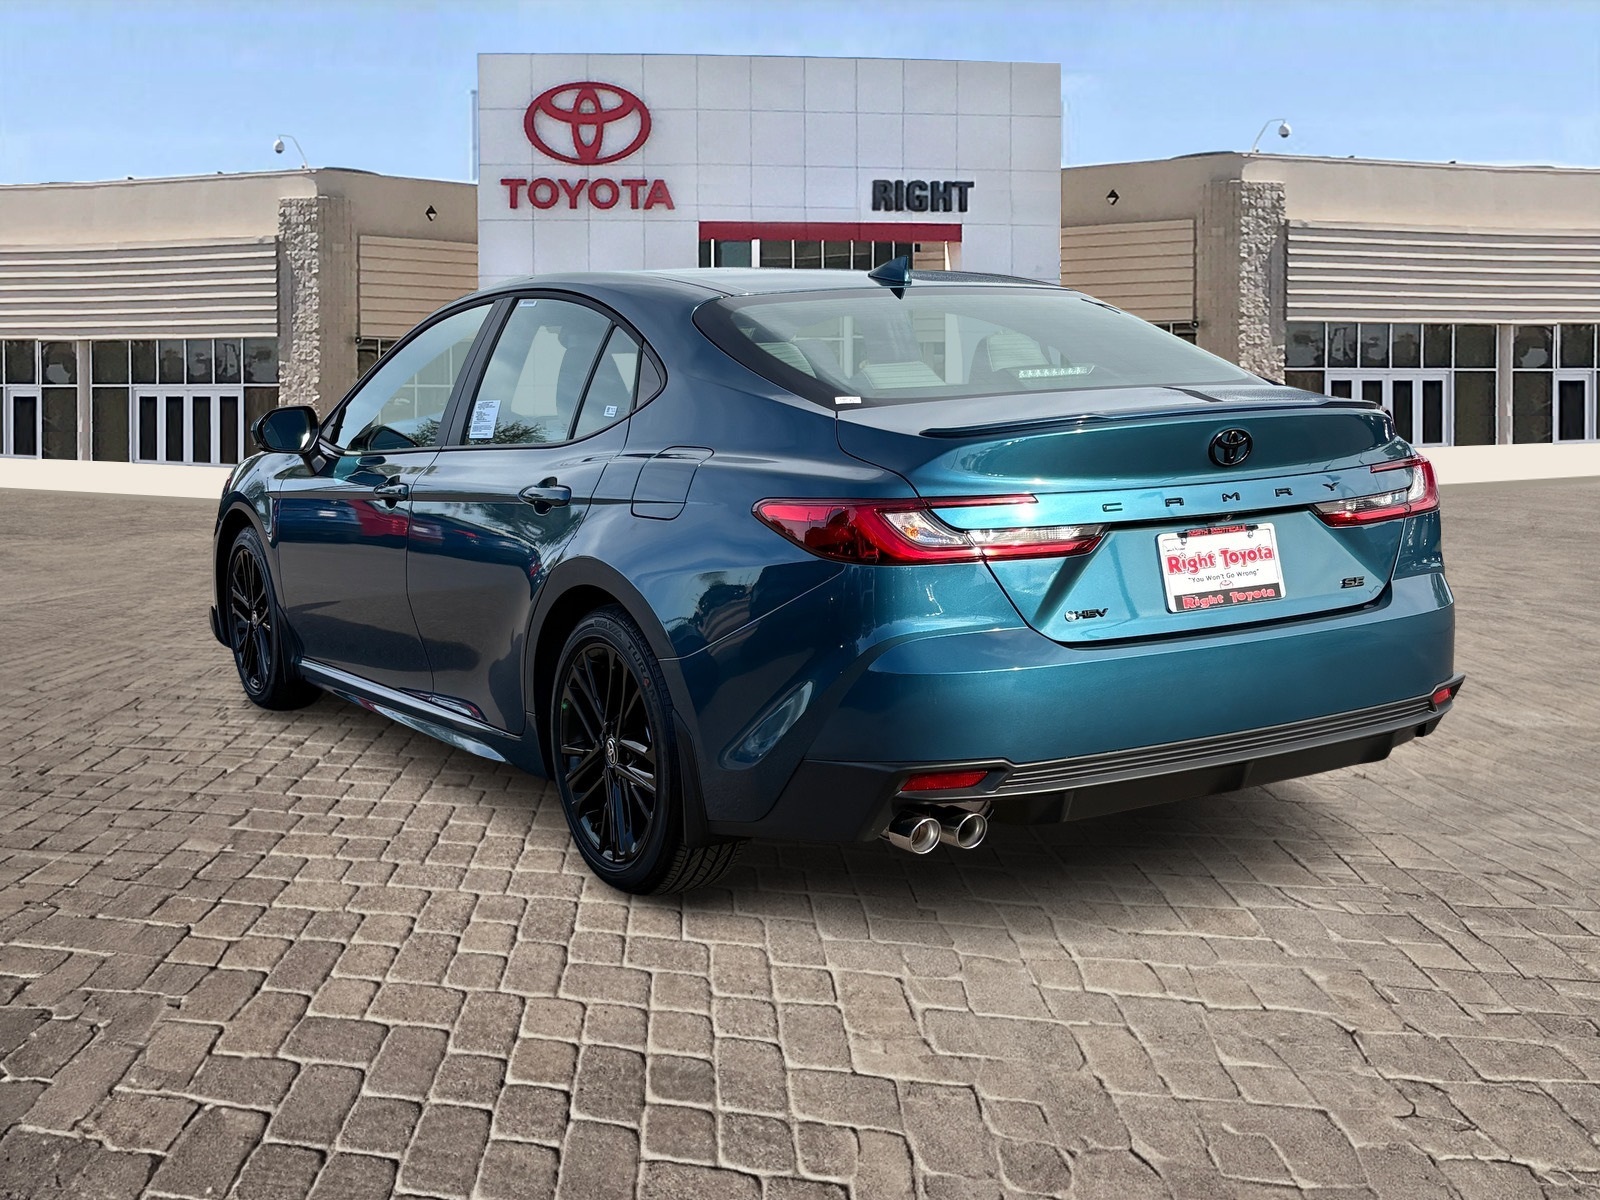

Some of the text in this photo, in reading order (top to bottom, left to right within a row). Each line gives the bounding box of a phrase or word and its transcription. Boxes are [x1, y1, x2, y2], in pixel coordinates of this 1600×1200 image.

[500, 178, 675, 210] TOYOTA
[871, 180, 975, 213] RIGHT
[1102, 481, 1340, 513] CAMRY
[1165, 545, 1274, 575] Right Toyota
[1205, 572, 1225, 581] Won't
[1226, 571, 1235, 579] Go
[1236, 568, 1259, 579] Wrong"
[1341, 576, 1365, 589] SE
[1182, 587, 1275, 610] Right Toyota
[1074, 607, 1109, 620] HEV
